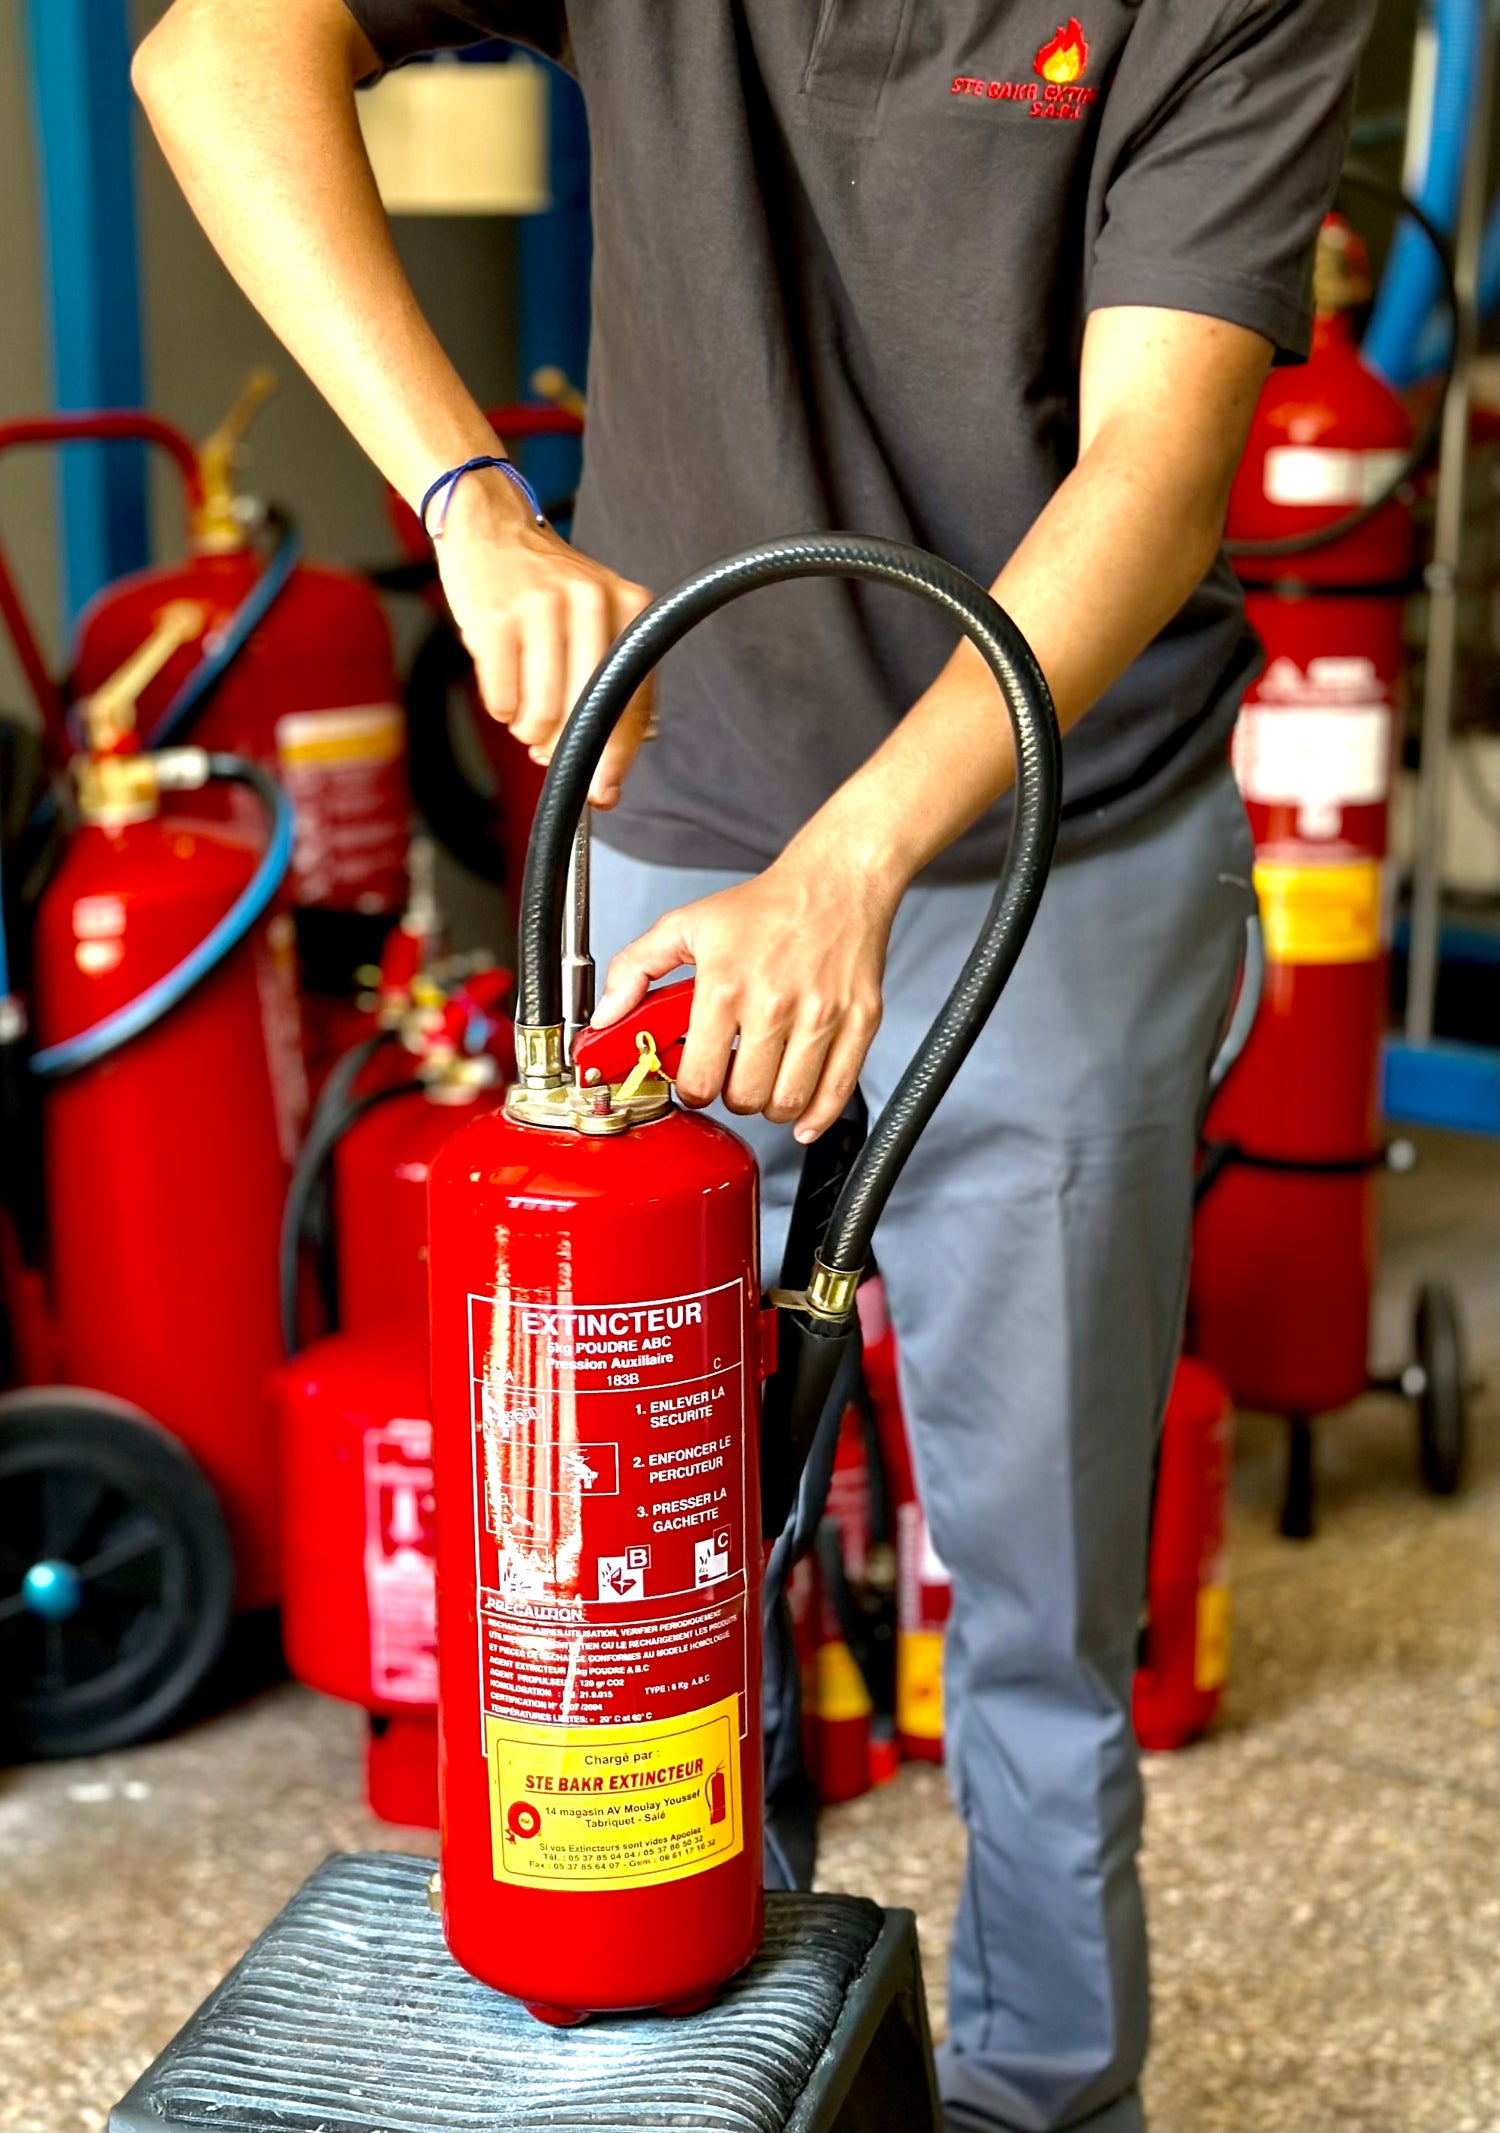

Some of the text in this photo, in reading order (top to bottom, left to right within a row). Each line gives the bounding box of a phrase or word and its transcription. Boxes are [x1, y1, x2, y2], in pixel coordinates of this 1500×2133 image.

[951, 77, 986, 96] STE
[521, 1302, 702, 1337] EXTINCTEUR
[575, 1340, 638, 1355] POUDRE
[641, 1335, 672, 1350] ABC
[546, 1357, 608, 1371] Pression
[713, 1357, 721, 1369] C
[607, 1373, 640, 1387] 183B
[635, 1386, 725, 1415] 1. ENLEVER LA
[650, 1404, 713, 1429] SECURITE
[633, 1435, 732, 1468] 2. ENFONCER LE
[649, 1456, 724, 1484] PERCUTEUR
[637, 1487, 727, 1518] 3. PRESSER LA
[652, 1506, 719, 1533] GACHETTE
[717, 1532, 729, 1548] C
[629, 1549, 648, 1567] B
[601, 1641, 614, 1649] OU
[616, 1641, 627, 1649] LE
[628, 1630, 693, 1649] RECHARGEMENT
[695, 1626, 708, 1637] LES
[620, 1625, 658, 1637] VERIFIER
[588, 1653, 641, 1662] CONFORMES
[643, 1651, 655, 1660] AU
[656, 1645, 688, 1657] MODELE
[490, 1656, 514, 1669] AGENT
[589, 1667, 626, 1675] POUDRE
[517, 1674, 572, 1686] PROPULSEU
[607, 1679, 625, 1687] CO2
[645, 1685, 666, 1695] TYPE
[490, 1692, 547, 1709] CERTIFICATION
[584, 1753, 630, 1766] Chargé
[633, 1751, 653, 1764] par
[525, 1757, 704, 1792] STE BAKR EXTINCTEUR
[545, 1788, 701, 1819] 14 magasin AV Moulay Youssef
[585, 1816, 635, 1829] Tabriquet
[551, 1845, 566, 1853] vos
[568, 1844, 620, 1853] Extincteurs
[622, 1841, 643, 1851] sont
